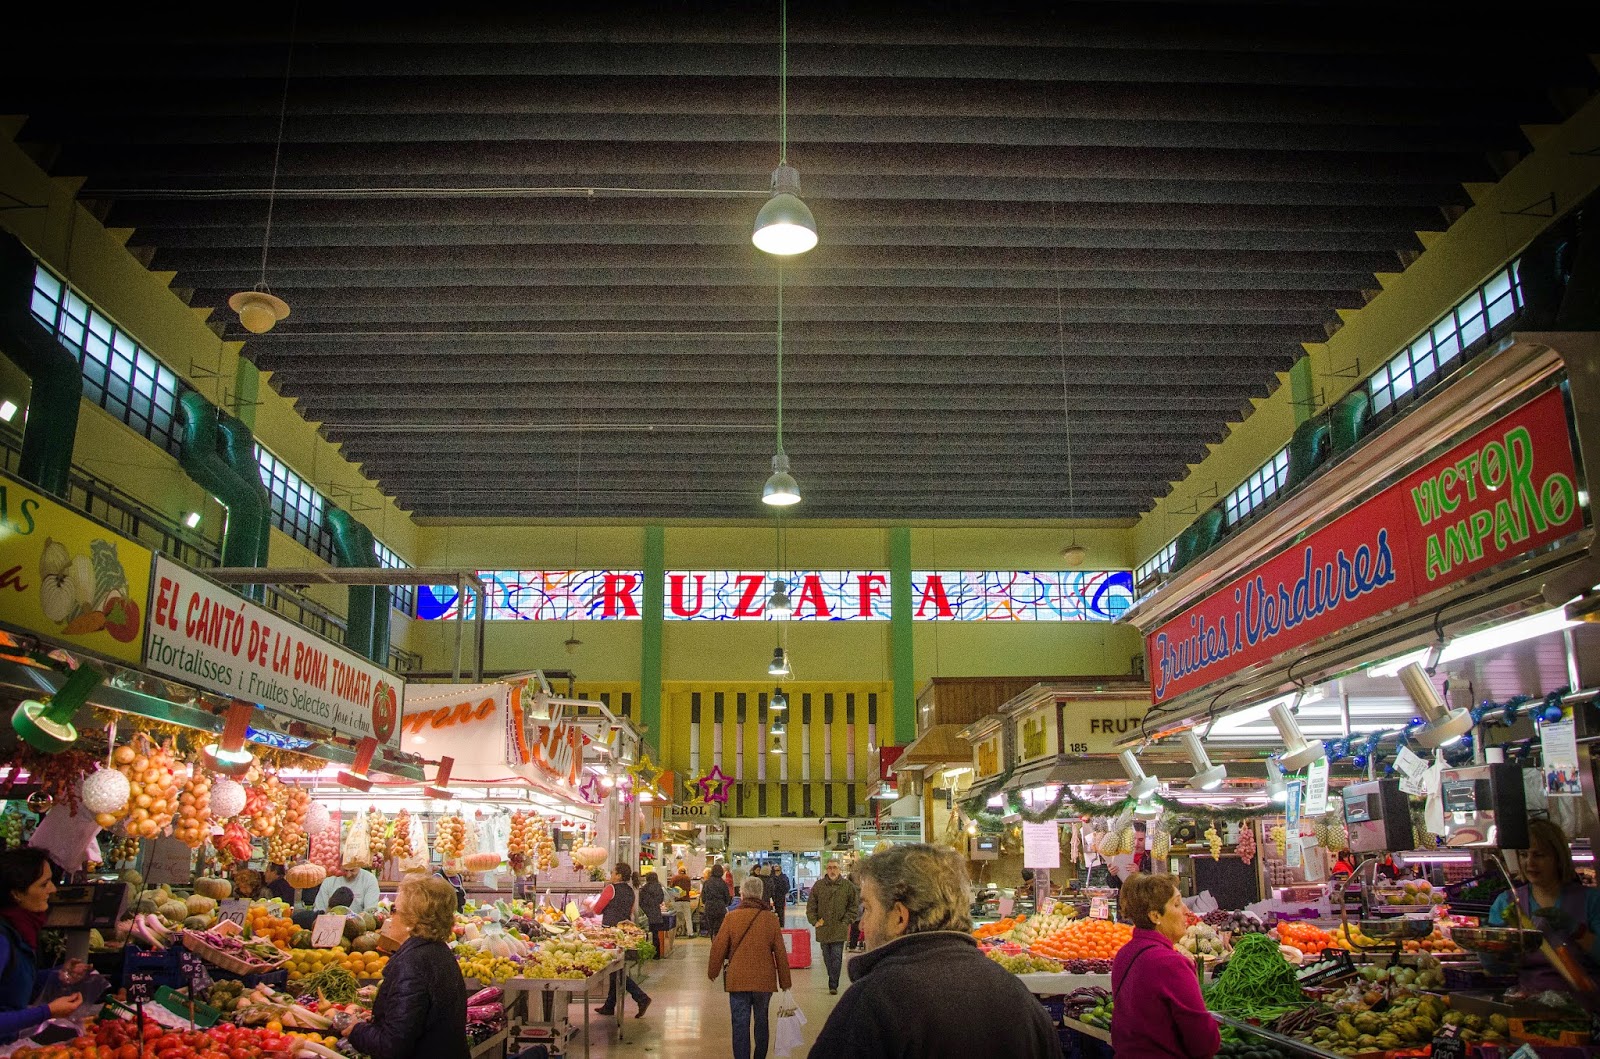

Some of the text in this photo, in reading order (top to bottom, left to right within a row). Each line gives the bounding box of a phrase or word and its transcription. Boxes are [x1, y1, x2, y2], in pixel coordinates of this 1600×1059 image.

[1410, 425, 1548, 538] VICTOR
[1426, 460, 1575, 581] AMPARO
[155, 576, 371, 708] EL CANTÓ DE LA BONA TOMATA
[602, 575, 954, 617] RUZAFA
[1155, 527, 1396, 699] Fruites i Verdures
[148, 633, 233, 686] Hortalisses
[238, 671, 244, 690] i
[248, 671, 288, 705] Fruites
[290, 687, 330, 719] Selectes
[1069, 743, 1088, 752] 185
